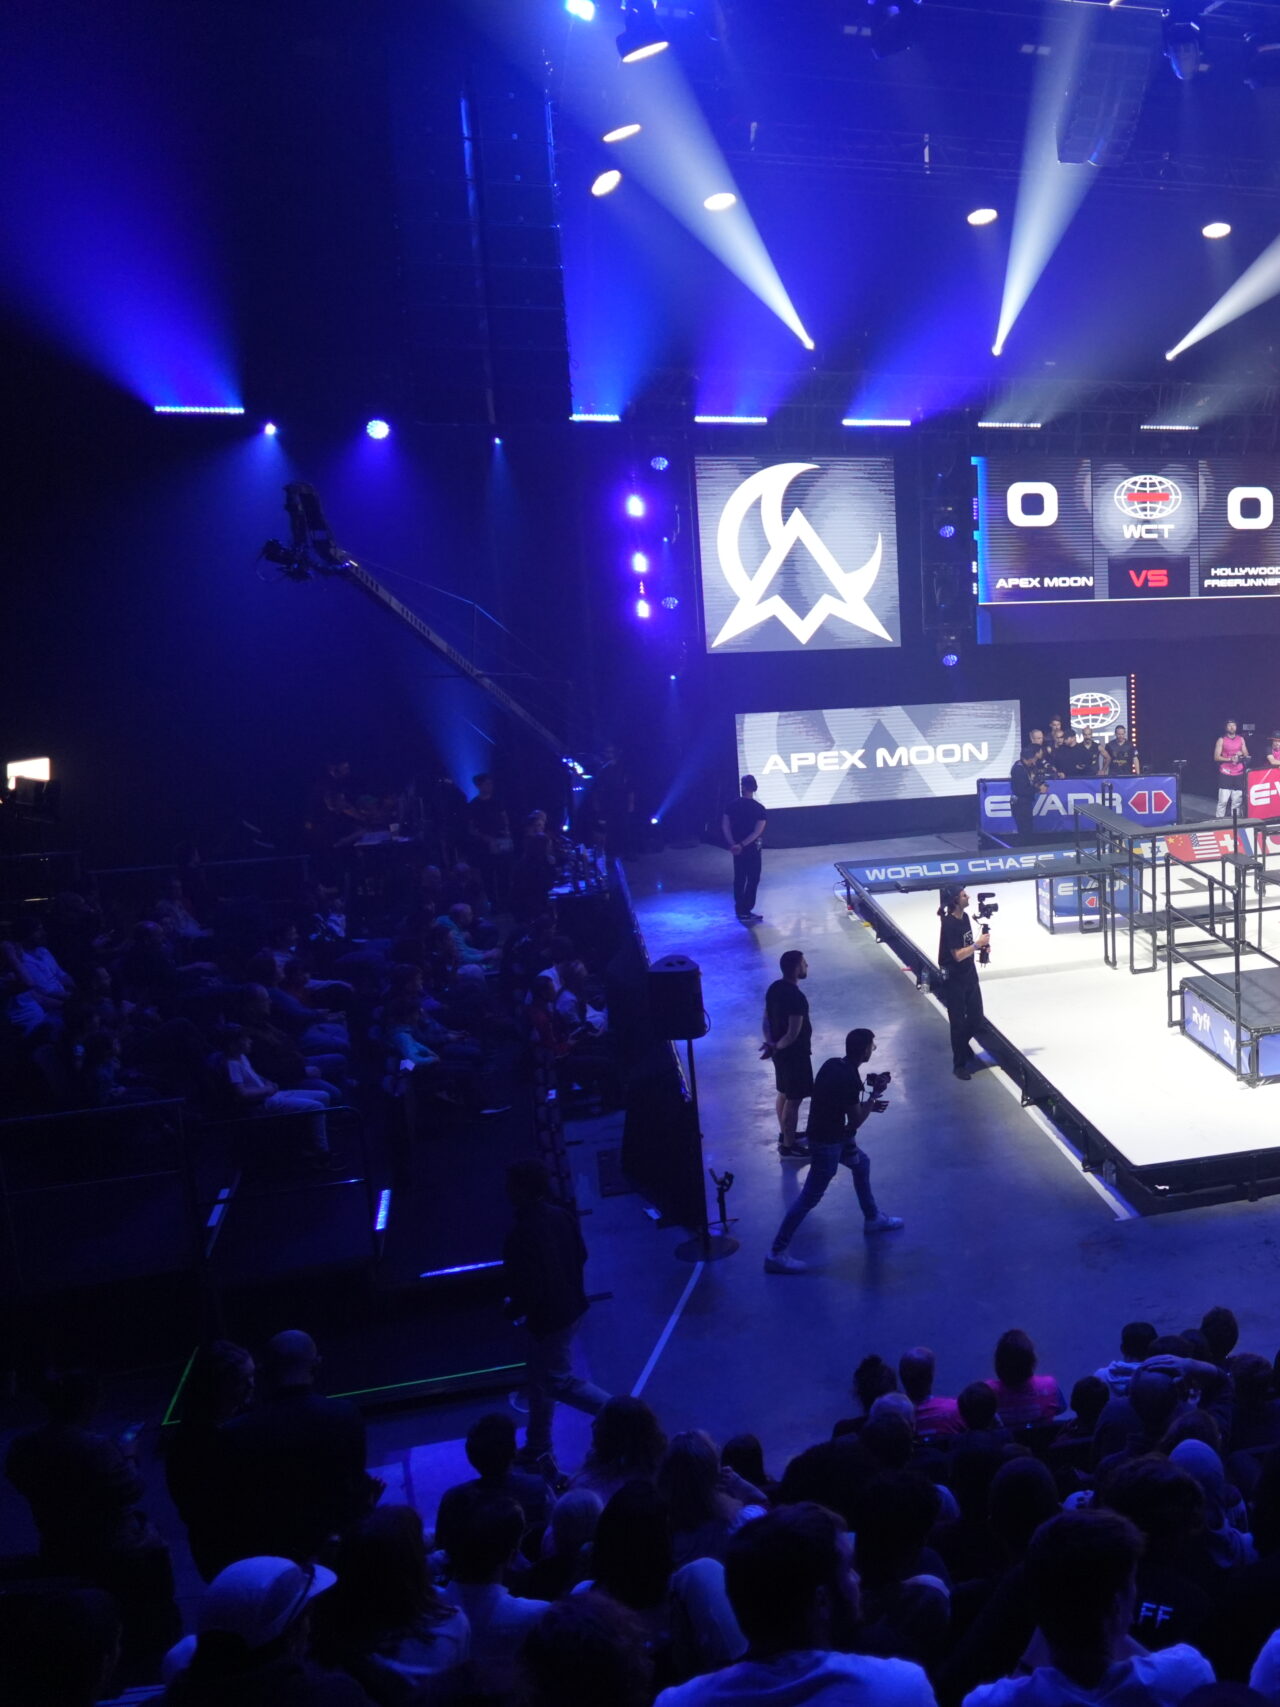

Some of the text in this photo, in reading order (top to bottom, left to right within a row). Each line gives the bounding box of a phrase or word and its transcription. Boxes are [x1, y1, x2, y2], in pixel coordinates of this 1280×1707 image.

[1122, 524, 1175, 539] WCT
[996, 576, 1094, 589] APEX MOON
[1128, 569, 1169, 588] VS
[762, 741, 988, 775] APEX MOON
[865, 862, 959, 881] WORLD
[1192, 1006, 1210, 1033] Ryff
